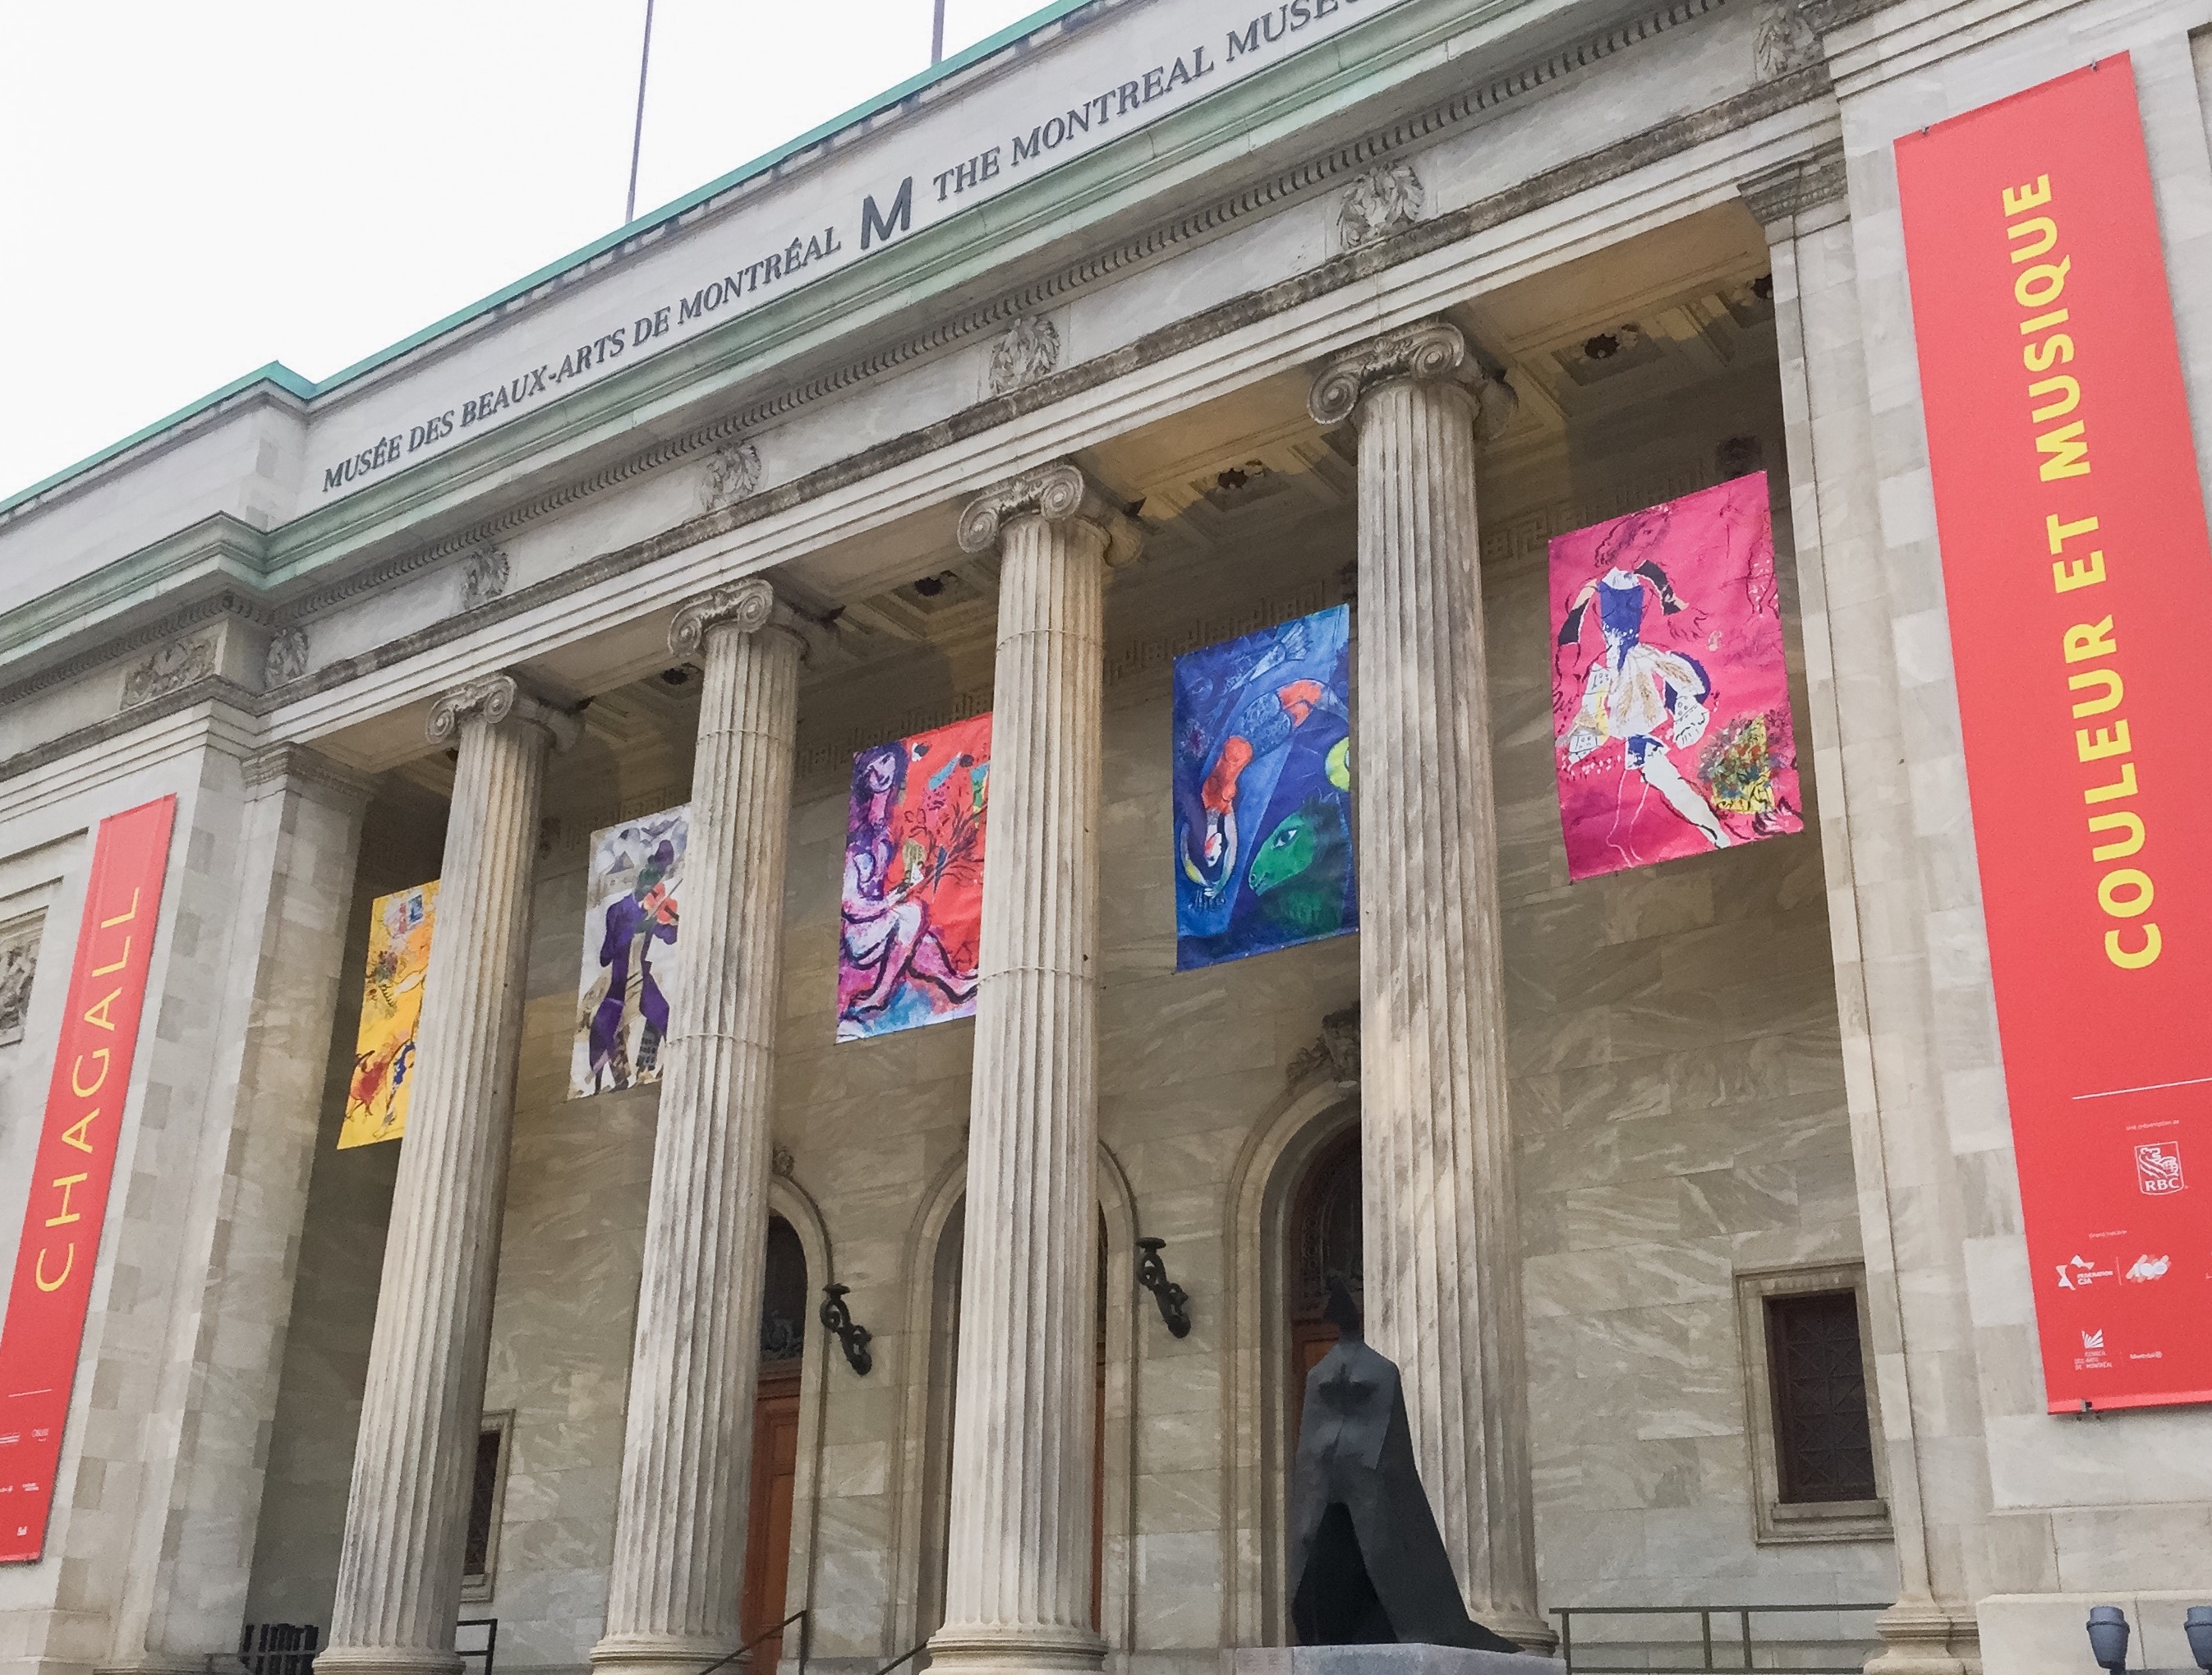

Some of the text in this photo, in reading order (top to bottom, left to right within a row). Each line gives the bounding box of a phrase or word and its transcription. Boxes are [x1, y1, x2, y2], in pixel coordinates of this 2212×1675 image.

[860, 176, 913, 251] M
[933, 0, 1356, 202] THE MONTREAL MUSE
[322, 226, 843, 493] MUSÉE DES BEAUX-ARTS DE MONTRÉAL
[2002, 173, 2163, 970] COULEUR ET MUSIQUE
[34, 886, 140, 1293] CHAGALL
[2145, 1177, 2180, 1191] RBC
